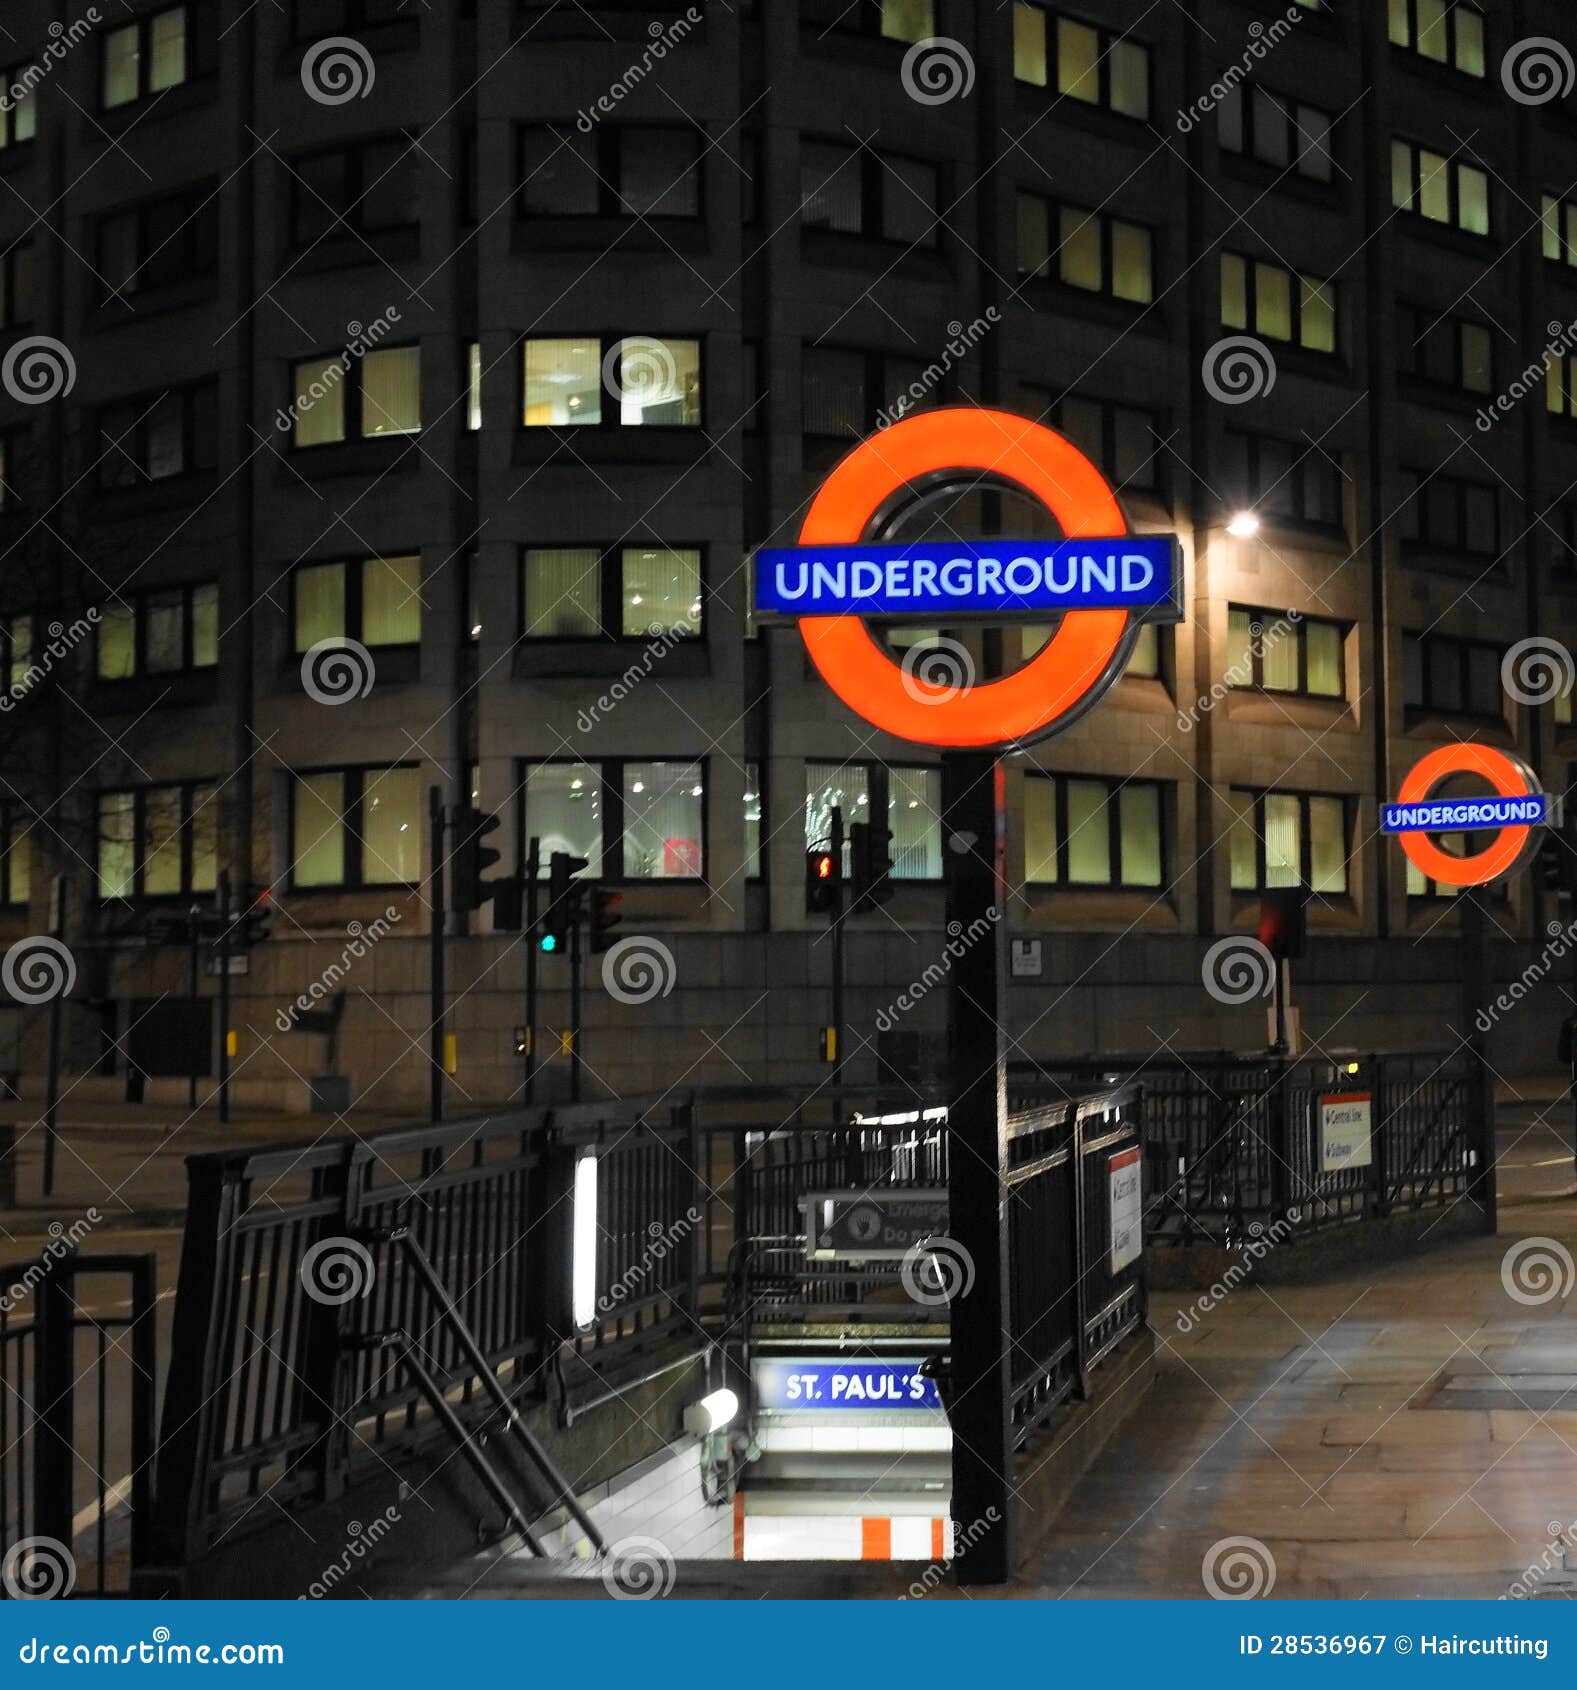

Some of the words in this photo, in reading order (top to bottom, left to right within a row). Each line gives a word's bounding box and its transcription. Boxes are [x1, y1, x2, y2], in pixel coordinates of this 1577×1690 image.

[775, 554, 1154, 600] UNDERGROUND
[1386, 801, 1542, 827] UNDERGROUND
[786, 1374, 822, 1400] ST.
[832, 1374, 926, 1400] PAUL'S
